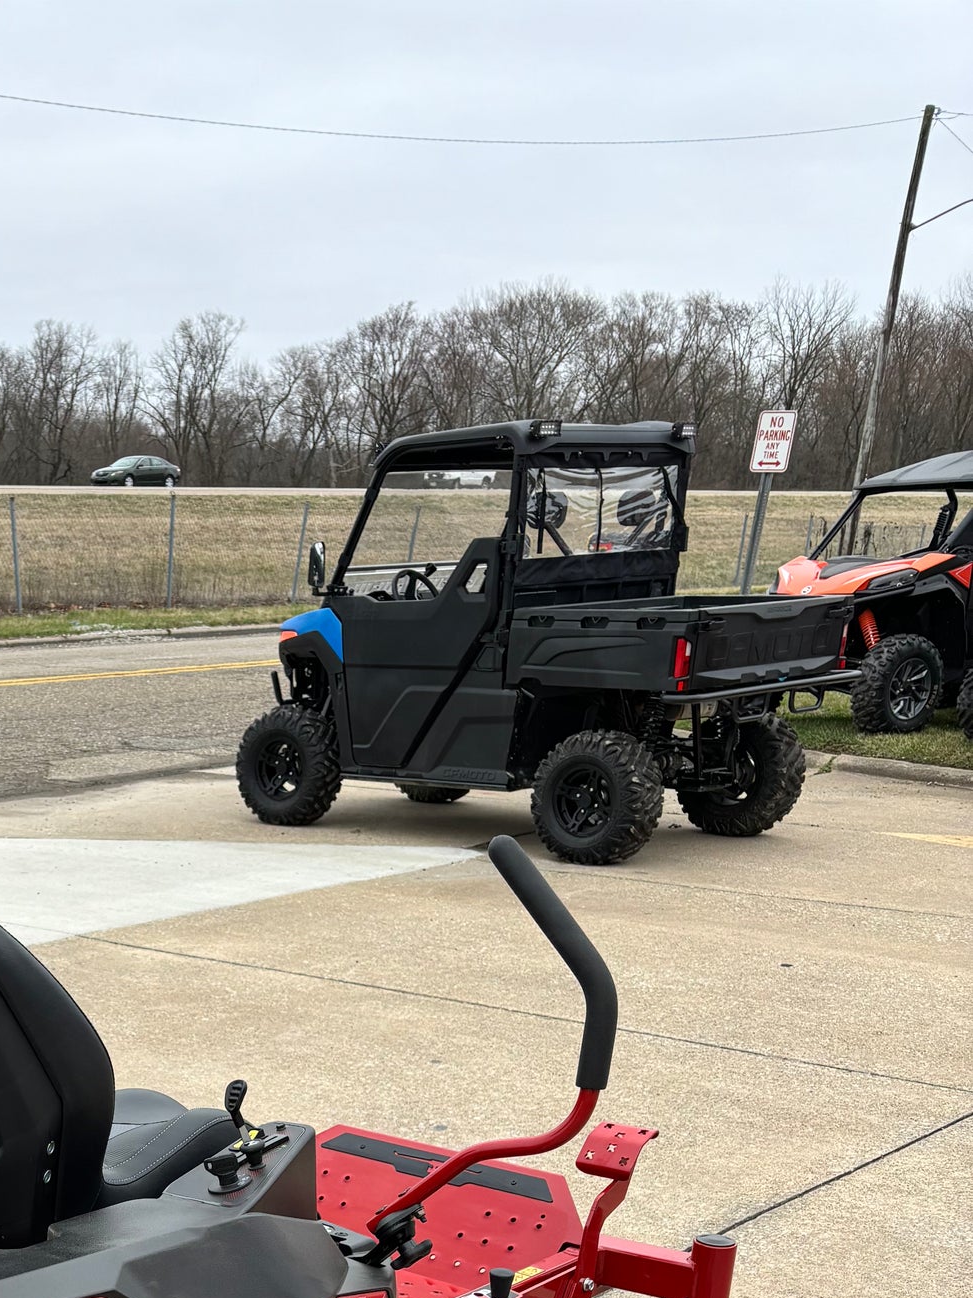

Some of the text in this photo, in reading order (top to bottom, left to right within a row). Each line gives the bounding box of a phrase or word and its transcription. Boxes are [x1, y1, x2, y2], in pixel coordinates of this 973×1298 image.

[770, 416, 784, 428] NO
[758, 429, 791, 441] PARKING
[765, 442, 780, 450] ANY
[763, 451, 779, 459] TIME
